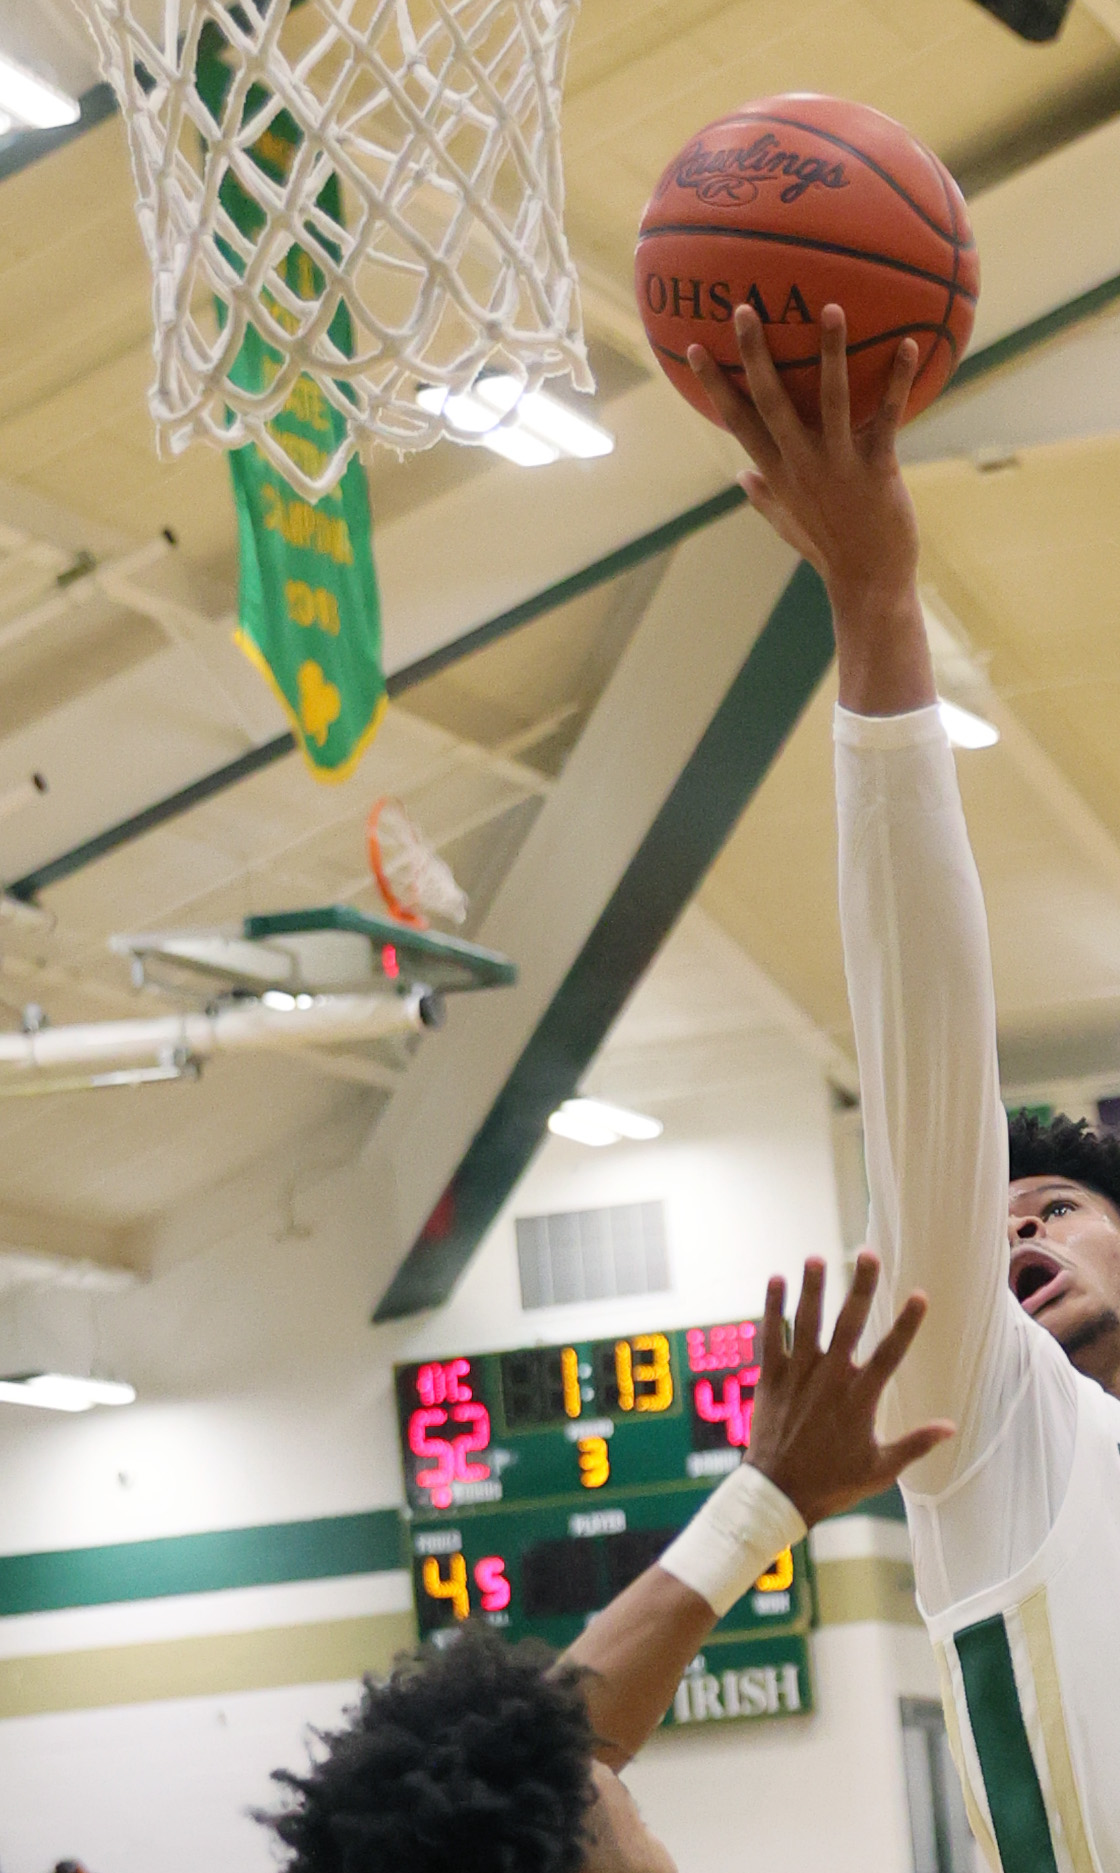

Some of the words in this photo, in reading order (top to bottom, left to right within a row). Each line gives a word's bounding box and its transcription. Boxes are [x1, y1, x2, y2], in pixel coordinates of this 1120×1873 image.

[676, 133, 850, 204] Rawlings
[646, 273, 814, 325] OHSAA
[560, 1333, 674, 1419] 1:13
[408, 1401, 491, 1488] 52
[577, 1436, 610, 1489] 3
[674, 1663, 800, 1723] IRISH
